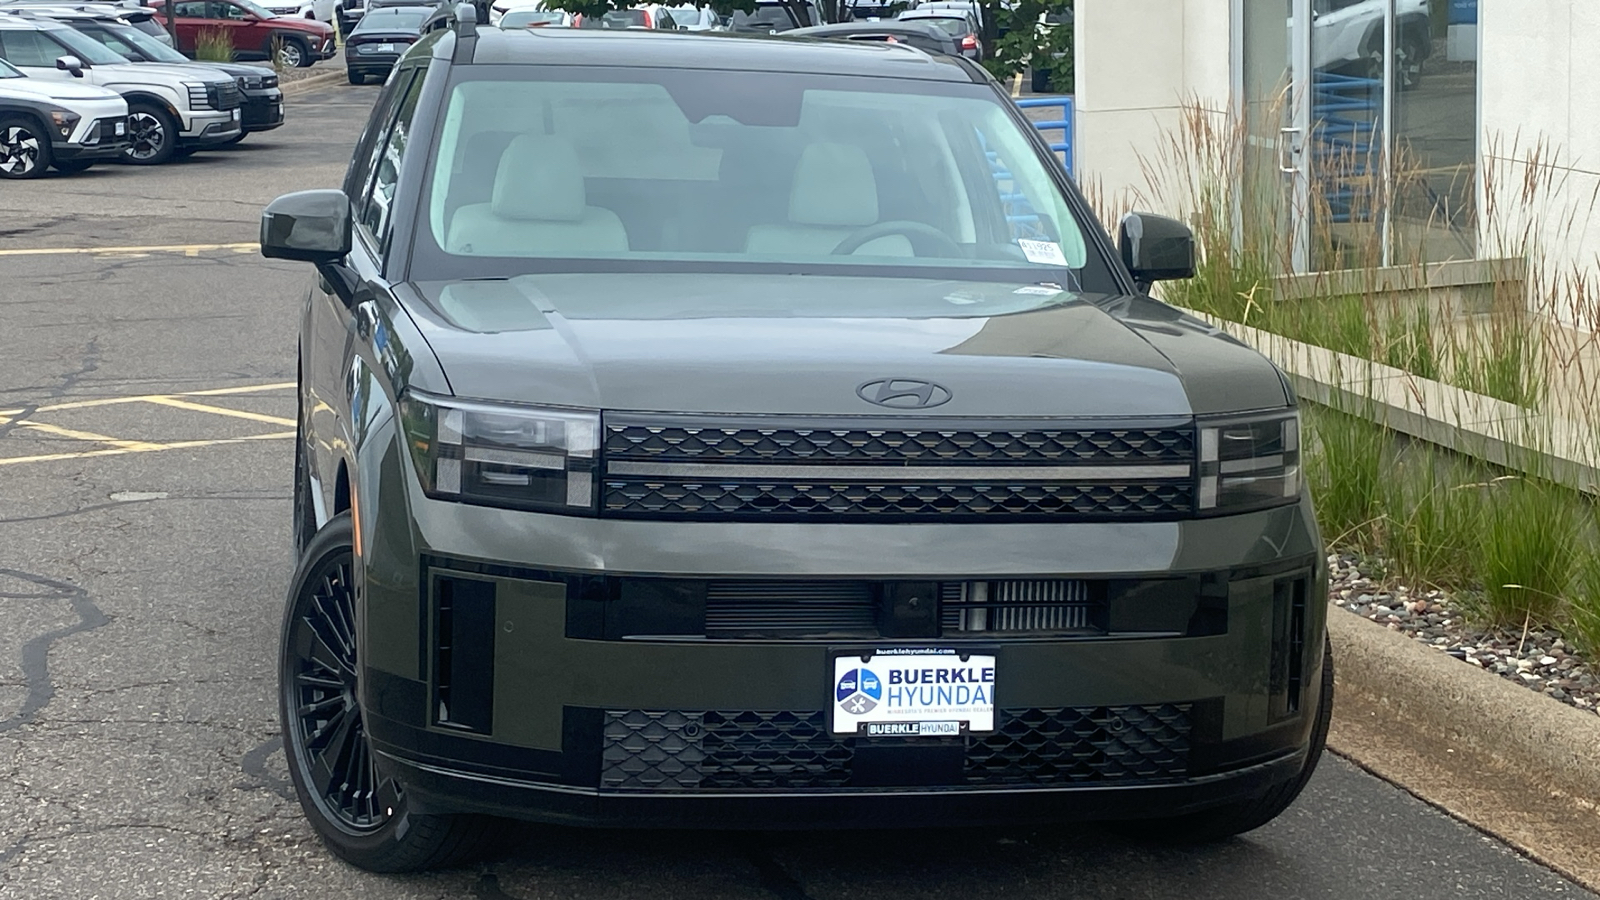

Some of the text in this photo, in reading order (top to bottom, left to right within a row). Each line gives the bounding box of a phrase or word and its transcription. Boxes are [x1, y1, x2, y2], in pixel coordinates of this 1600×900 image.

[889, 668, 994, 684] BUERKLE
[888, 685, 994, 707] HYUNDAI
[870, 723, 957, 734] BUERKLE HYUNDAI
